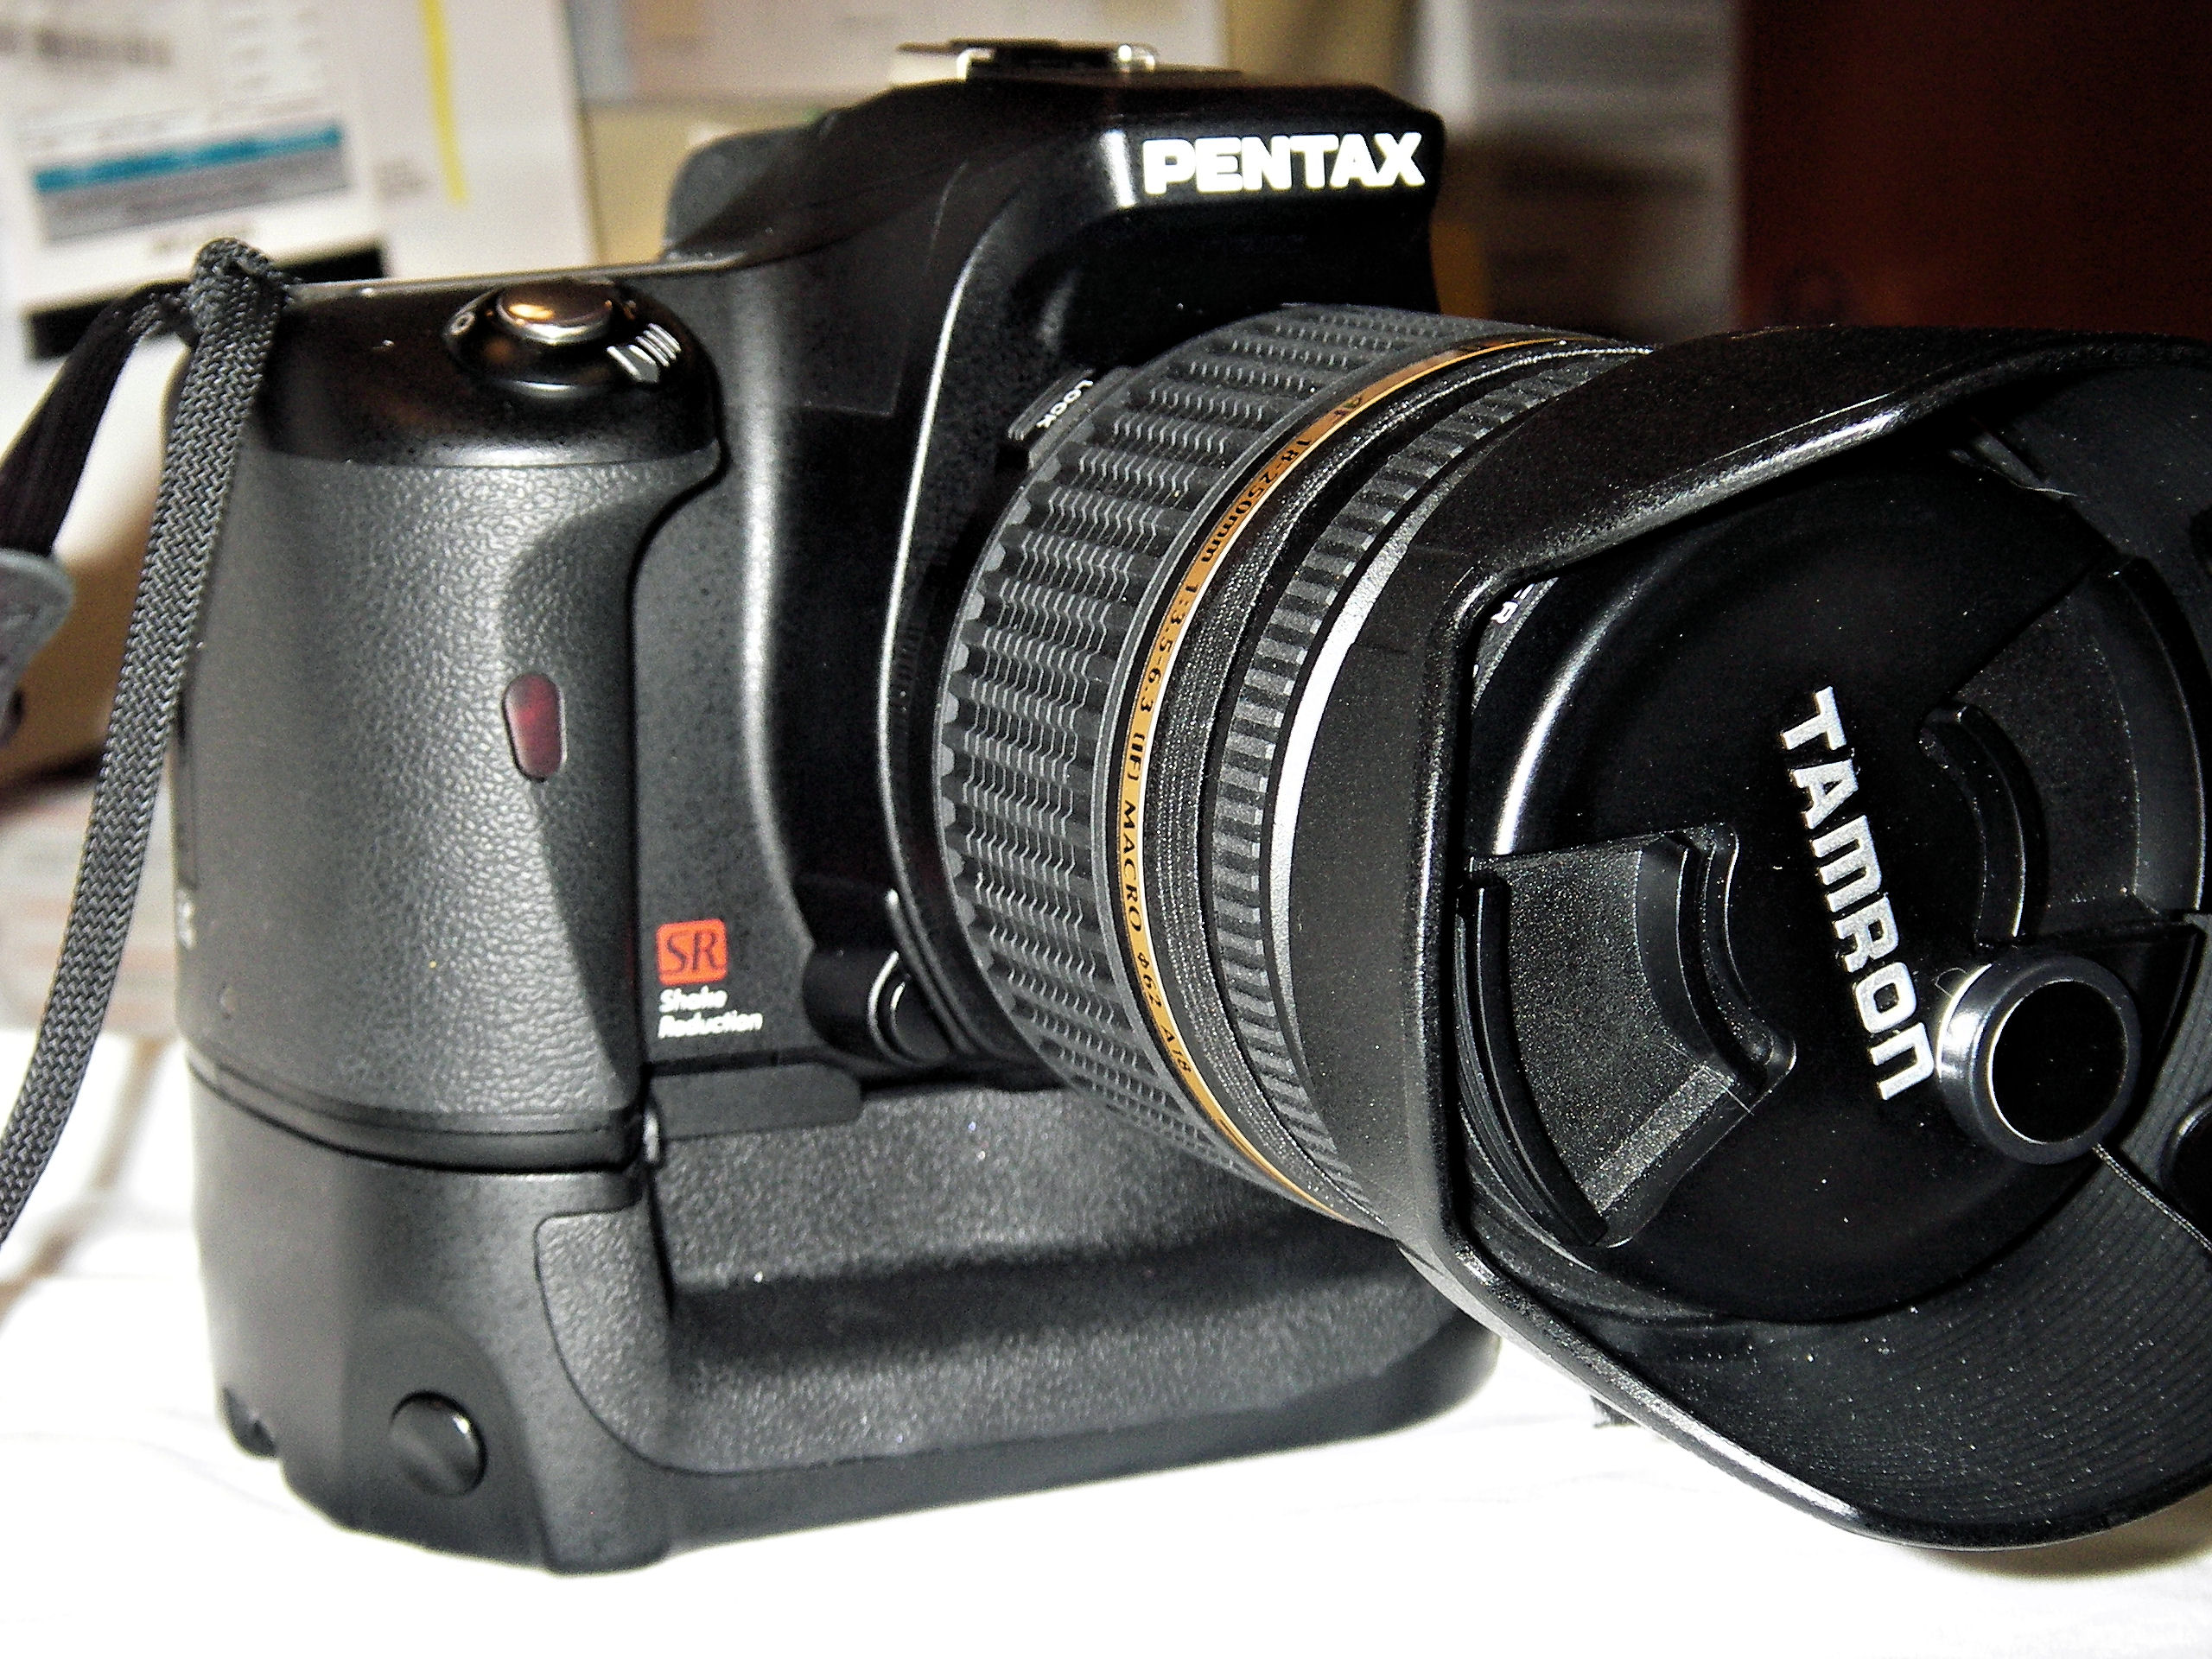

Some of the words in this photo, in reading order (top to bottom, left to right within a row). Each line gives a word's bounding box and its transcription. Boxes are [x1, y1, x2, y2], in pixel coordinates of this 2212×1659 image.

[1142, 132, 1426, 195] PENTAX
[1036, 379, 1094, 429] LOCK
[1781, 686, 1935, 1100] TAMRON
[659, 930, 720, 976] SR
[1122, 799, 1144, 932] MACRO
[1160, 1025, 1192, 1073] A18
[658, 1009, 763, 1039] Reduction
